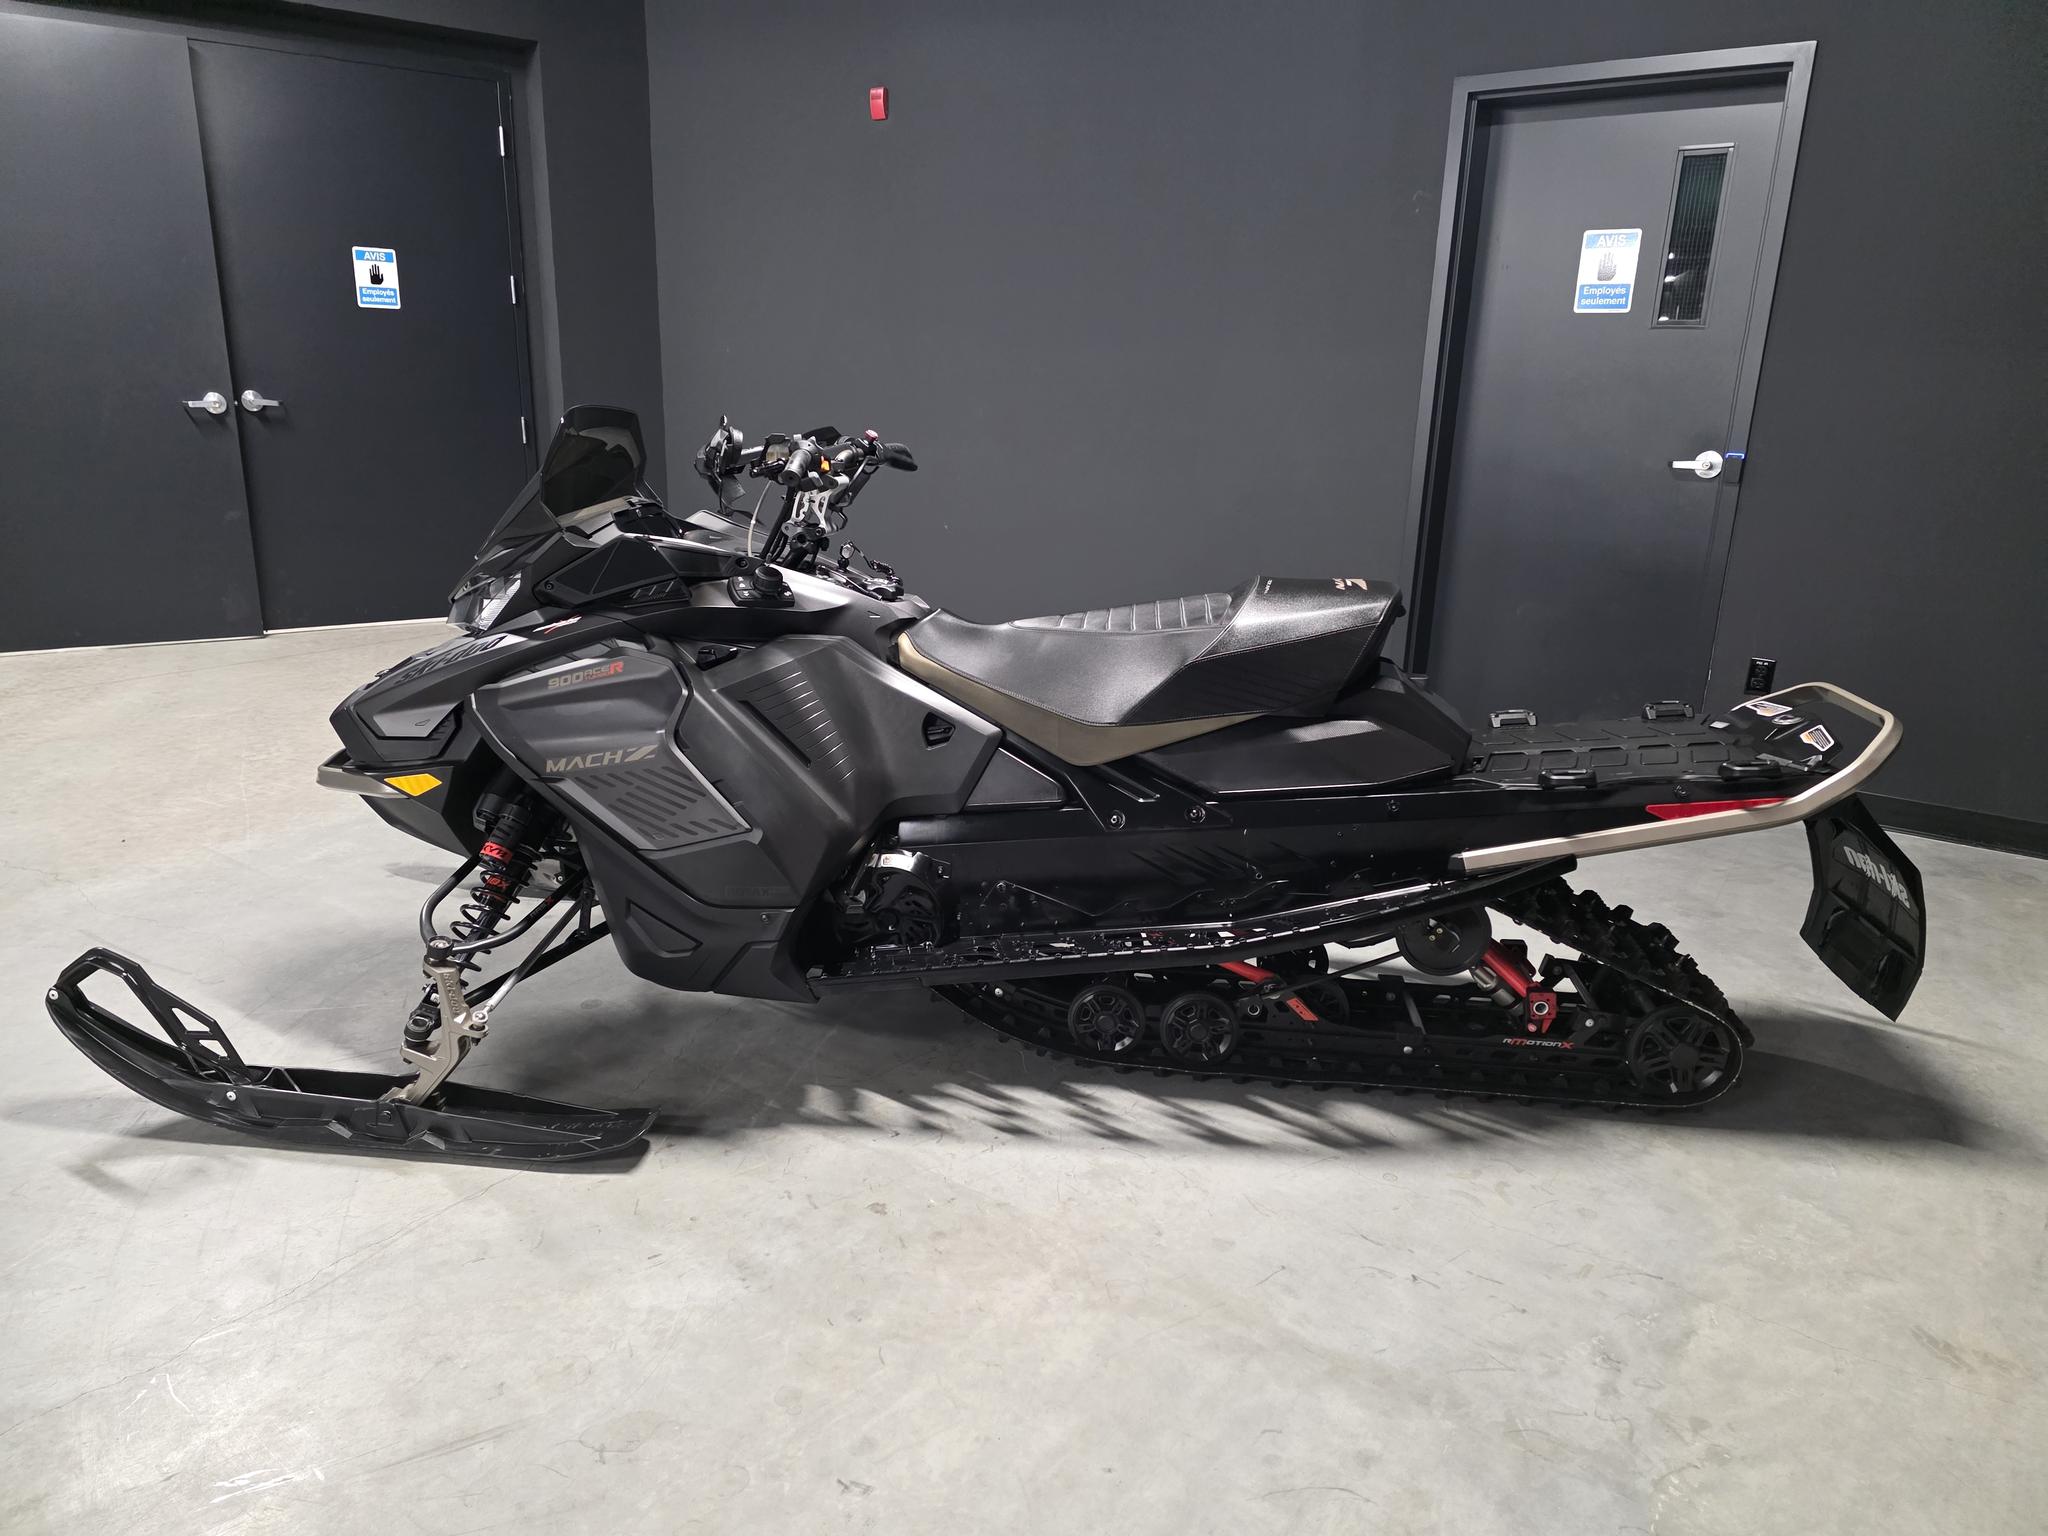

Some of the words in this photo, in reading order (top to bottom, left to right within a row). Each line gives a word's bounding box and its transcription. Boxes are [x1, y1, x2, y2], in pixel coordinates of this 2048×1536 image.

[1597, 234, 1627, 248] AVIS
[364, 251, 386, 261] AVIS
[1580, 297, 1626, 305] seulement
